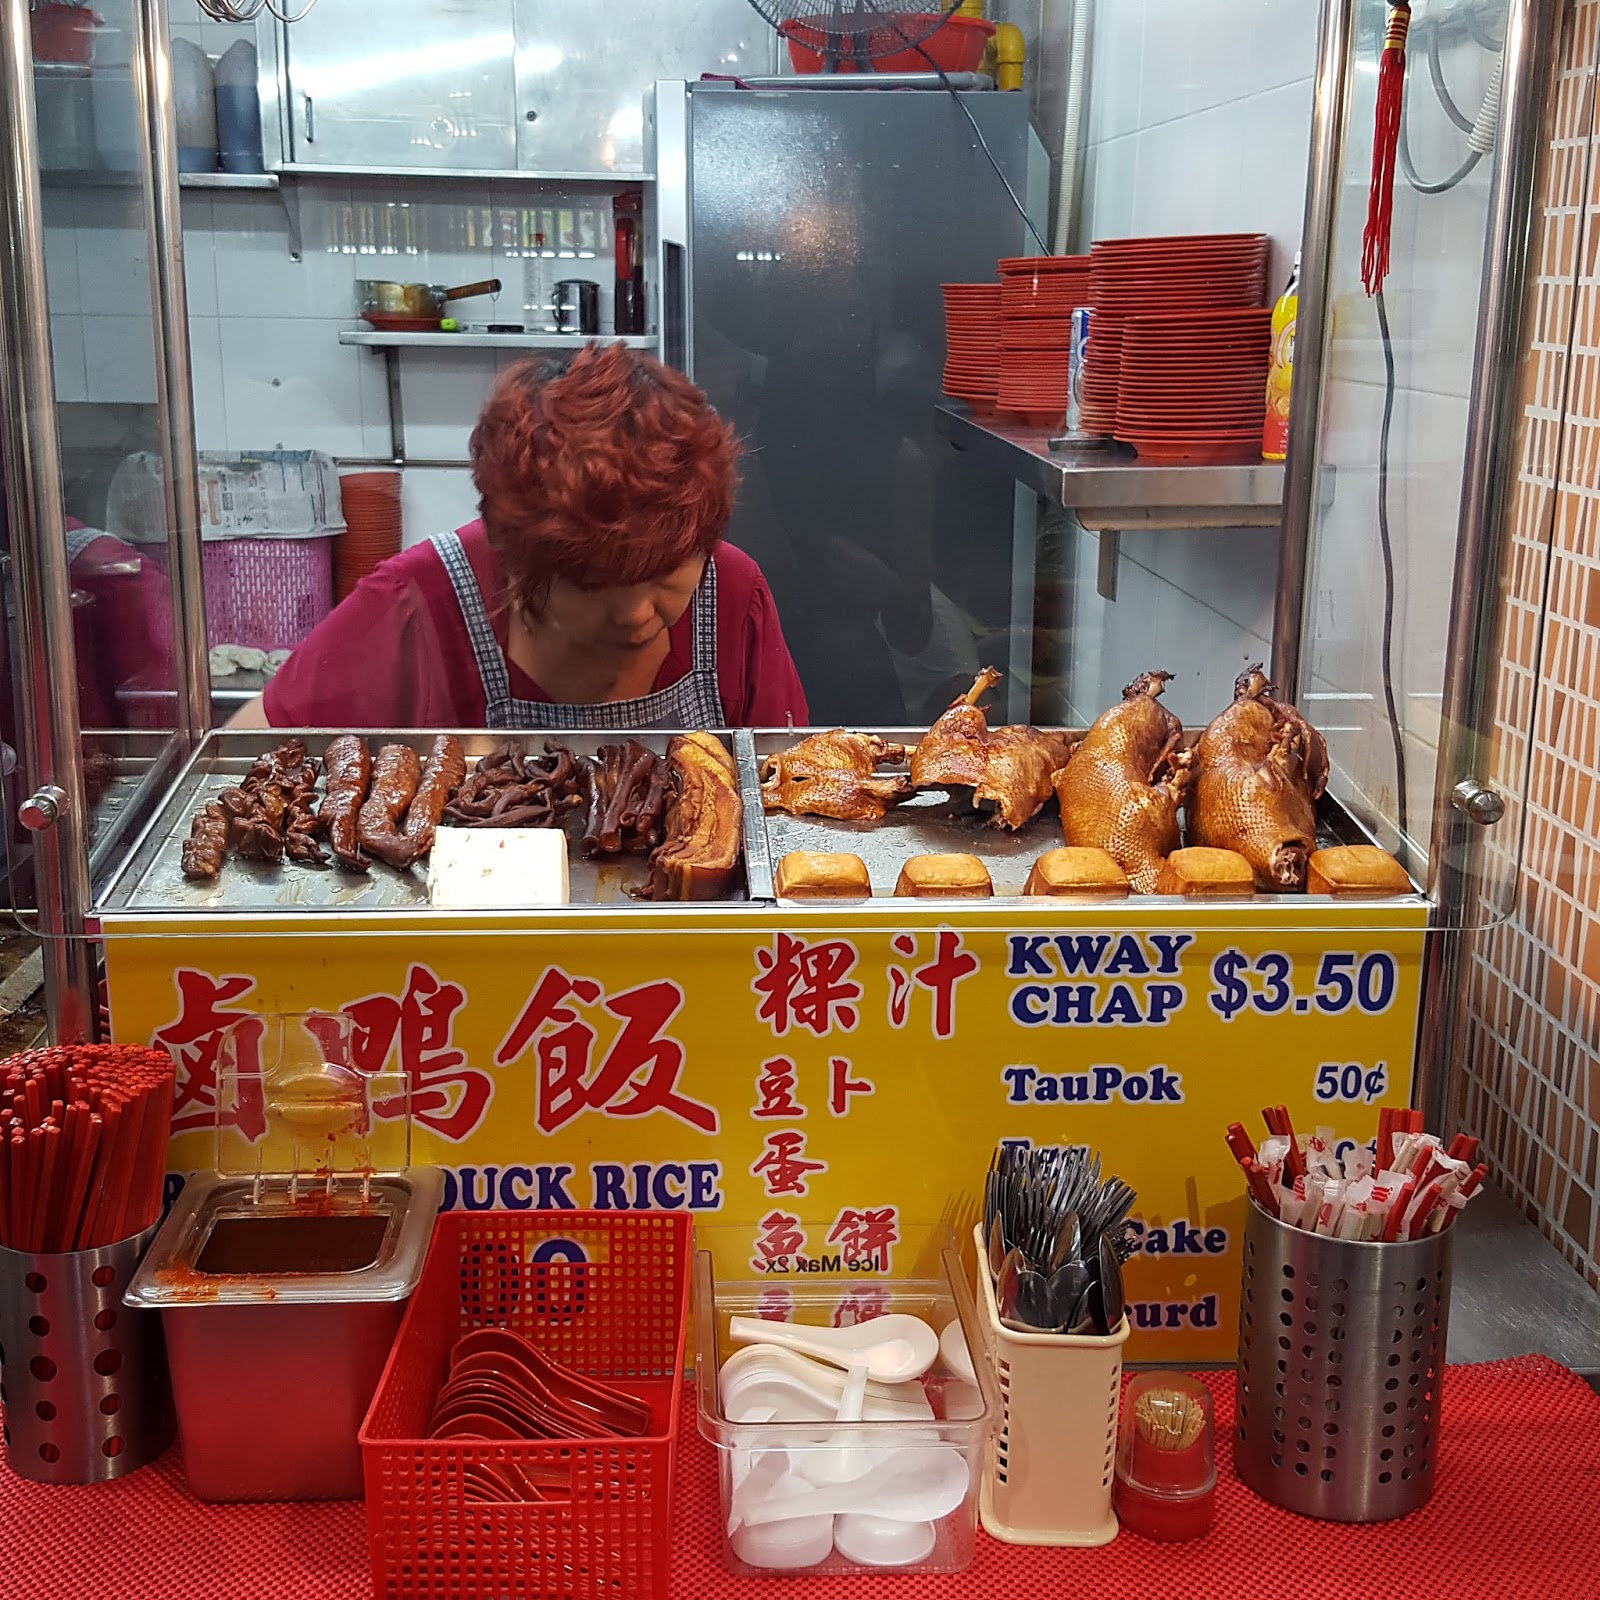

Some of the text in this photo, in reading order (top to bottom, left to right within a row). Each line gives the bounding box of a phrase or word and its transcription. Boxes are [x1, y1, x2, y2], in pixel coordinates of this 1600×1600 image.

[1008, 934, 1192, 974] KWAY
[1012, 984, 1183, 1024] CHAP
[1210, 949, 1395, 1019] $3.50
[1004, 1066, 1182, 1102] TauPok
[1316, 1063, 1385, 1102] 50¢
[753, 1132, 825, 1194] 蛋
[592, 1162, 721, 1210] RICE
[752, 1207, 897, 1271] 魚餅
